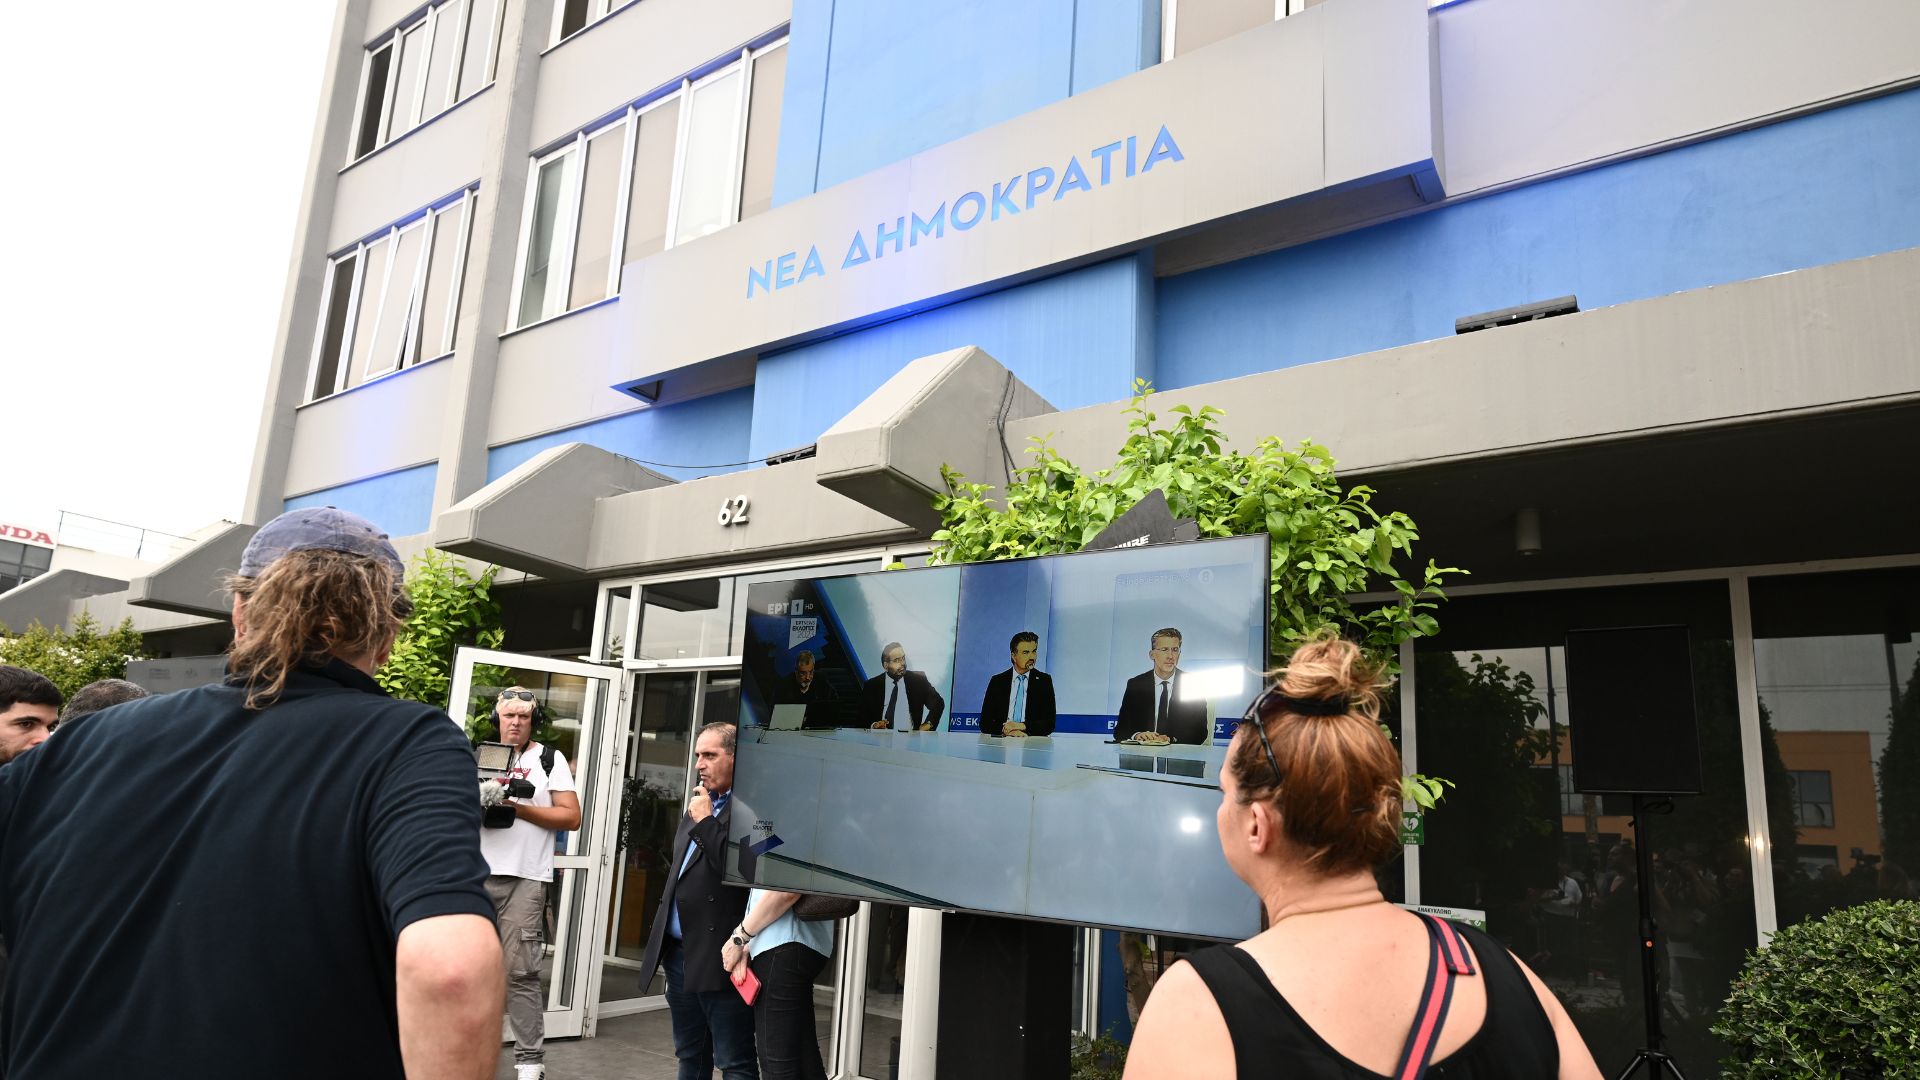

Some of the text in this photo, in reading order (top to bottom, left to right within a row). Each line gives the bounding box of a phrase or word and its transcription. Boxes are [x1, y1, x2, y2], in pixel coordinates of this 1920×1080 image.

[747, 123, 1185, 299] ΝΕΑ ΔΗΜΟΚΡΑΤΙΑ
[718, 495, 748, 525] 62
[965, 717, 980, 727] ΕΚ
